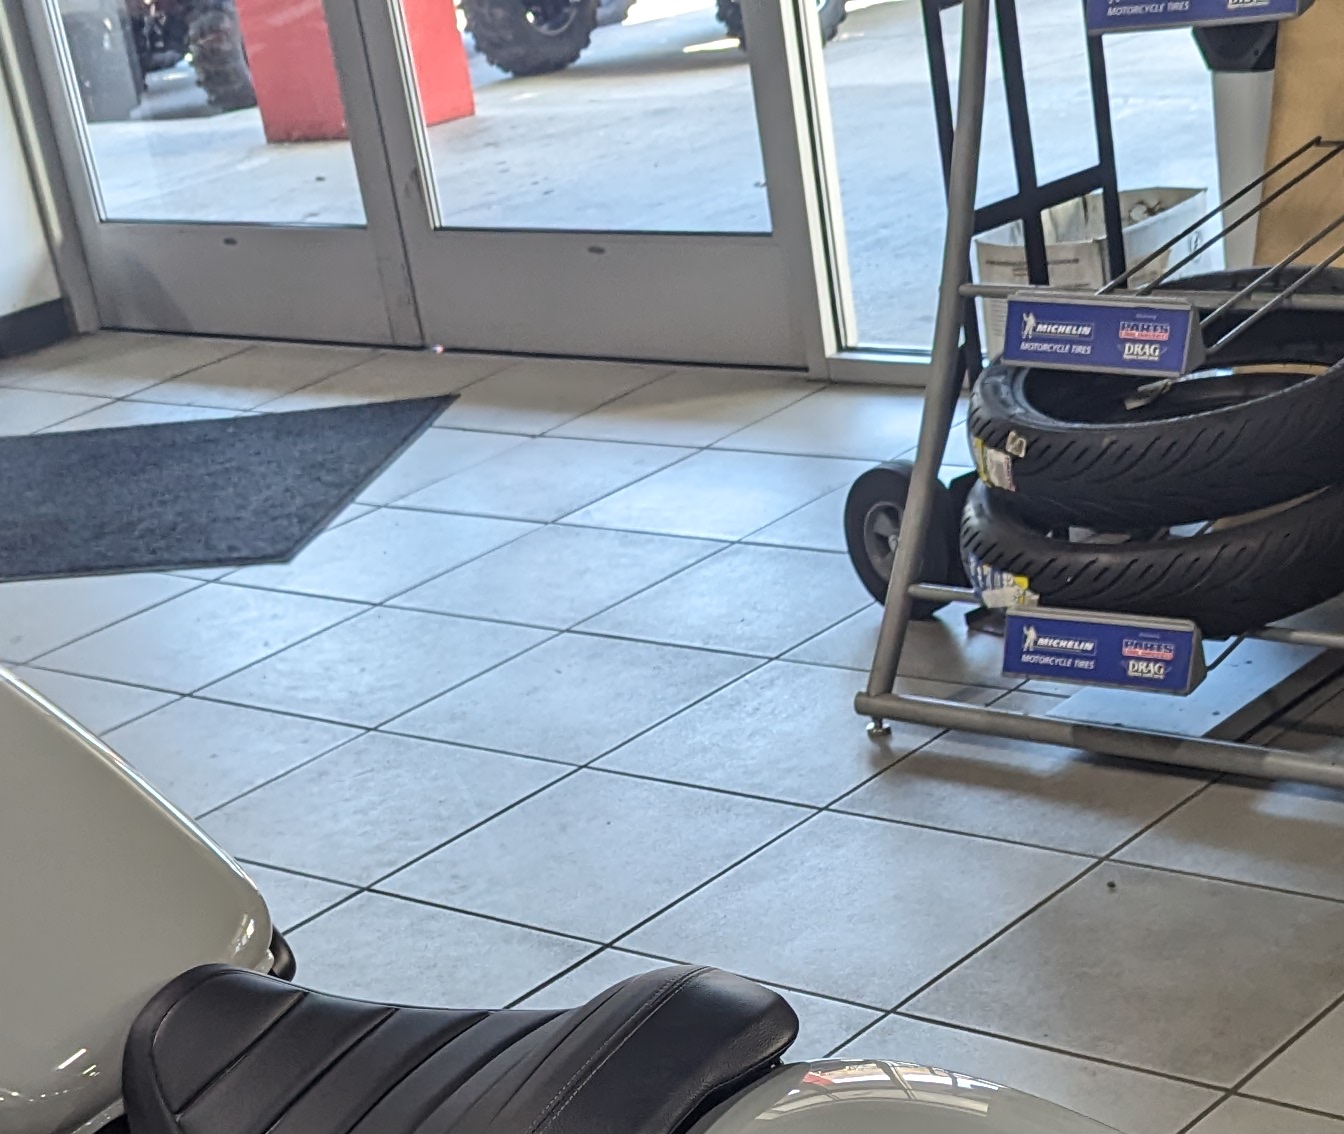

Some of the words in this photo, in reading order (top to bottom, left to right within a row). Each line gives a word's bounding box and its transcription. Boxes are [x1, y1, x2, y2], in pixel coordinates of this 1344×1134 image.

[1107, 4, 1164, 16] MOTORCYCLE
[1167, 2, 1189, 11] TIRES
[1036, 323, 1092, 336] MICHELIN
[1020, 342, 1070, 354] MOTORCYCLE
[1071, 344, 1092, 355] TIRES
[1125, 342, 1159, 356] DRAG
[1037, 637, 1094, 651] MICHELIN
[1021, 654, 1072, 668] MOTORCYCLE
[1074, 659, 1095, 670] TIRES
[1129, 660, 1164, 674] DRAG
